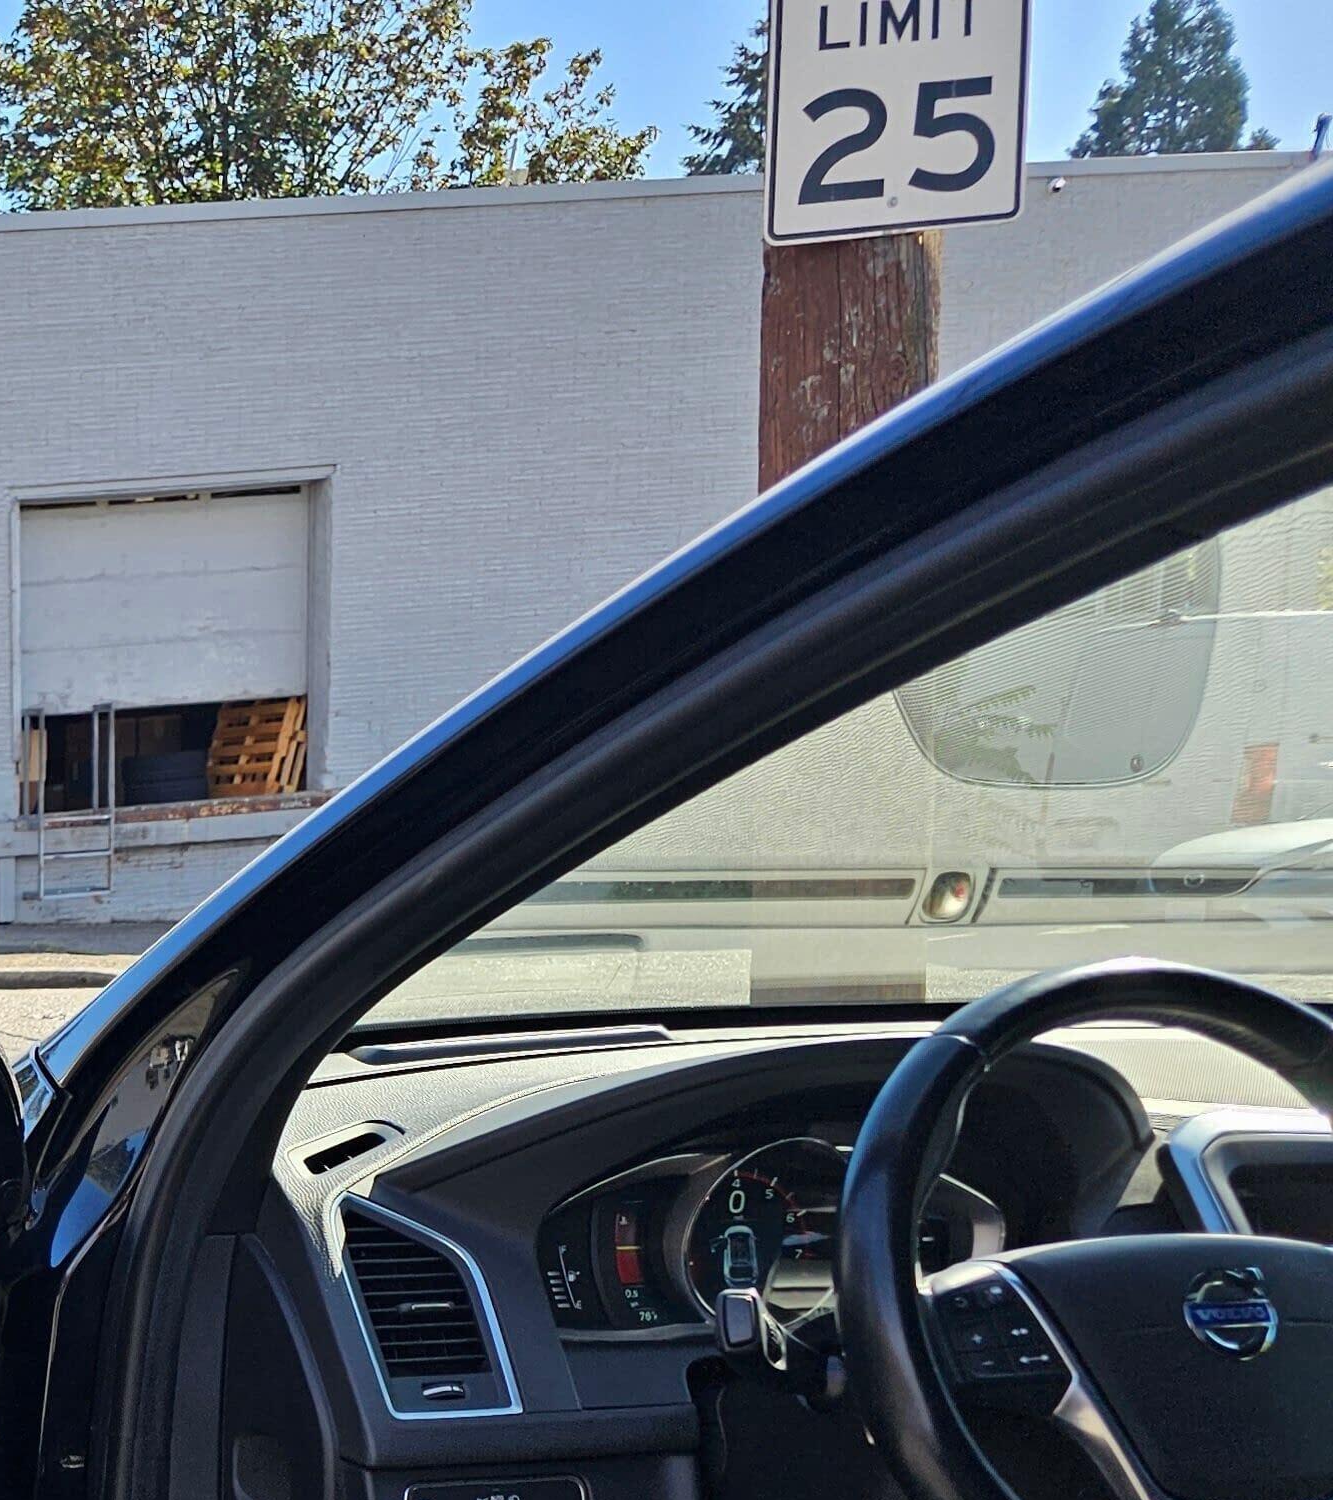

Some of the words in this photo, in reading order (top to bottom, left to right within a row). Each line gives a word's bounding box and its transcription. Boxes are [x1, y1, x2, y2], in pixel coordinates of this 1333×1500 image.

[798, 76, 995, 205] 25
[732, 1178, 741, 1188] 4
[765, 1189, 774, 1199] 5
[729, 1190, 745, 1214] 0
[786, 1213, 795, 1223] 6
[795, 1249, 803, 1259] 7
[1195, 1306, 1267, 1321] VOLVO
